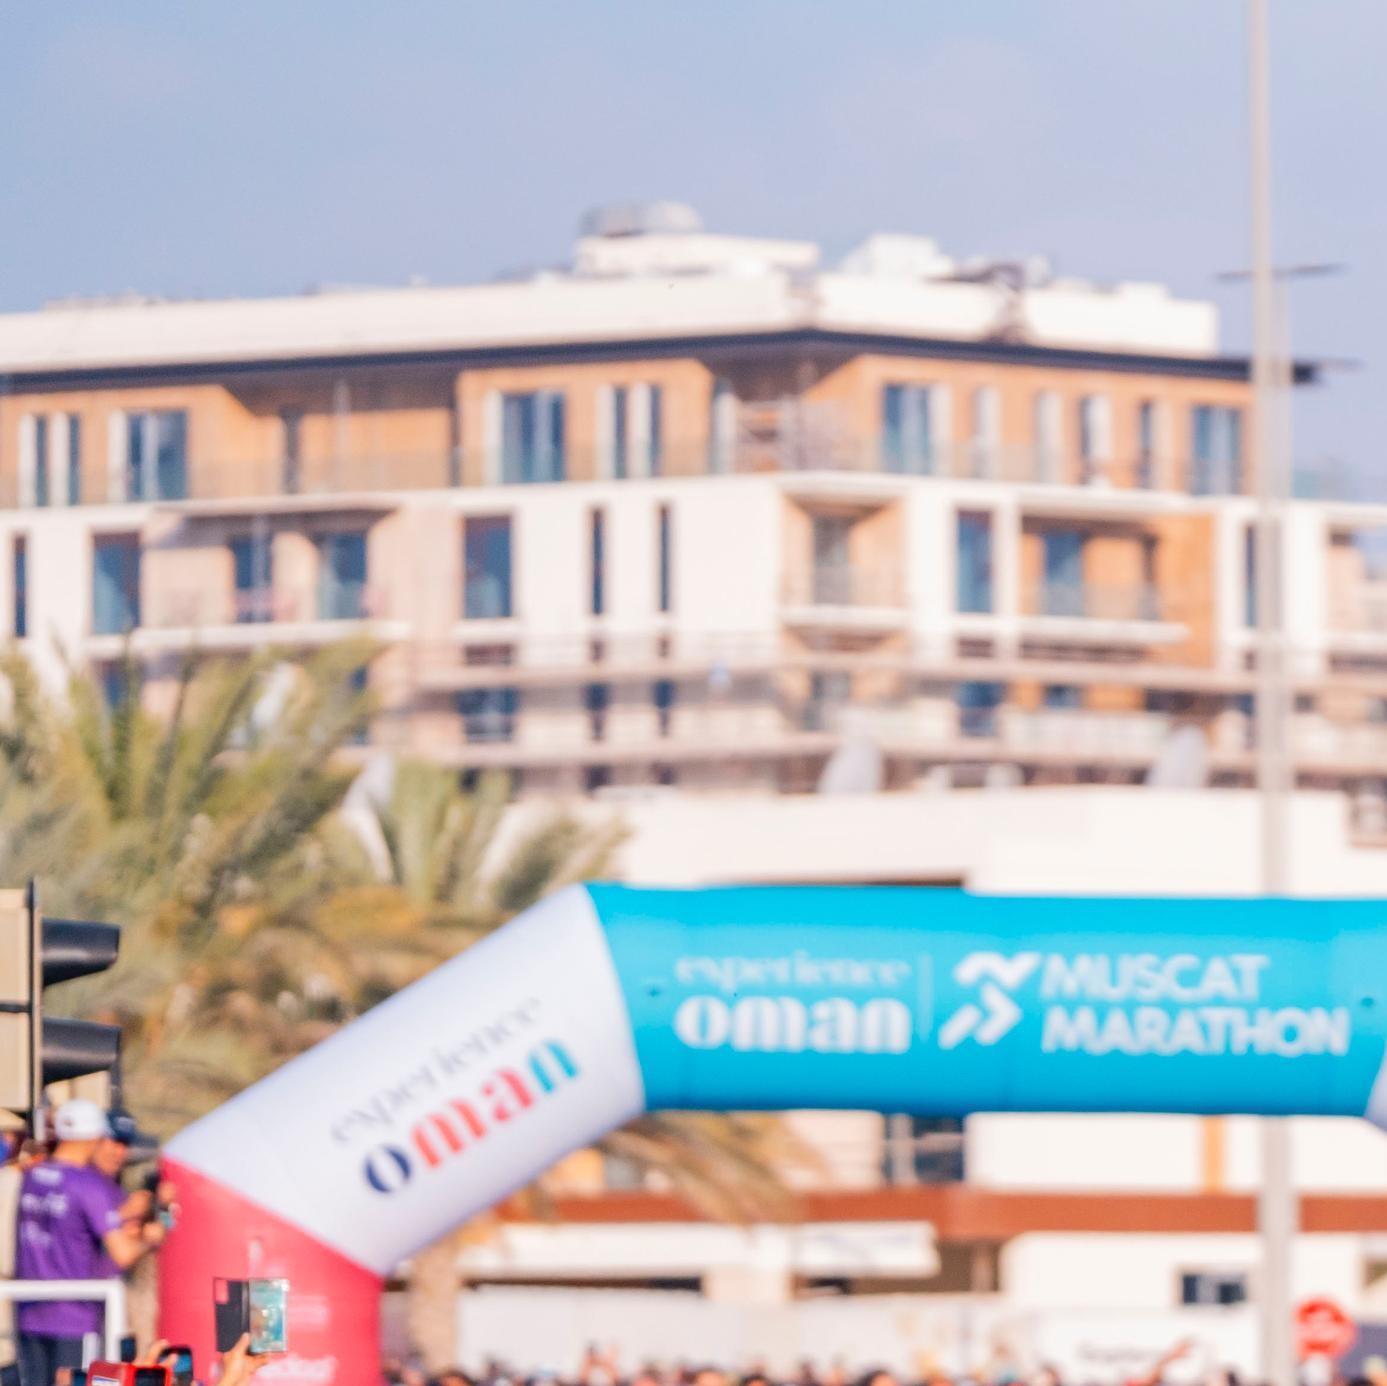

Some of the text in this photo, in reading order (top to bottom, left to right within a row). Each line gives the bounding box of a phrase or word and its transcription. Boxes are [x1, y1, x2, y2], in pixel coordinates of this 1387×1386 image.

[676, 952, 911, 995] experience
[1042, 953, 1270, 1002] MUSCAT
[674, 995, 912, 1055] oman
[1041, 1007, 1352, 1058] MARATHON
[333, 994, 544, 1146] experience
[363, 1036, 580, 1196] oman
